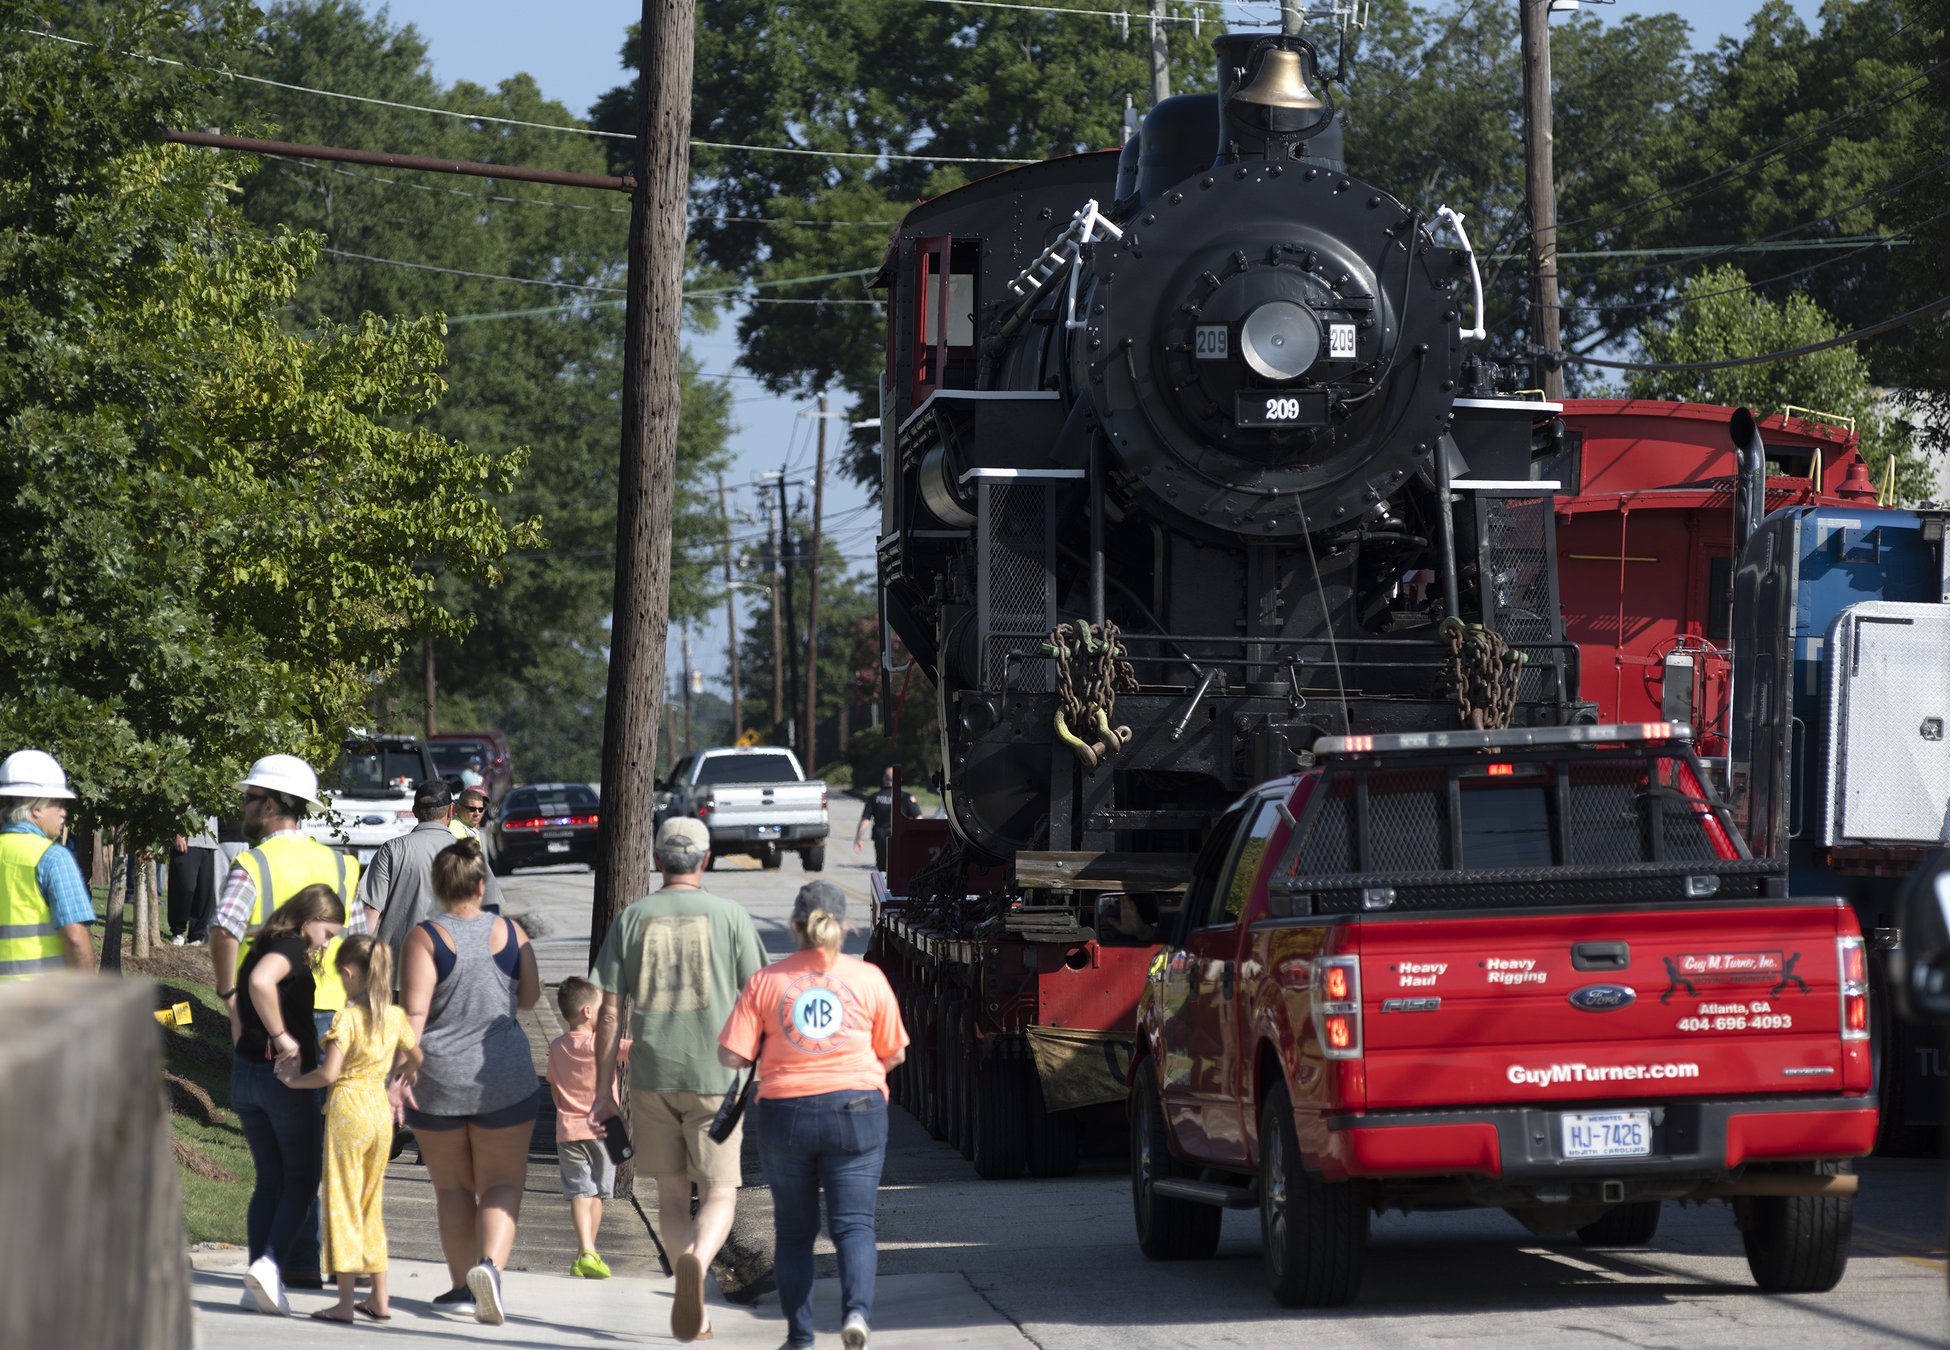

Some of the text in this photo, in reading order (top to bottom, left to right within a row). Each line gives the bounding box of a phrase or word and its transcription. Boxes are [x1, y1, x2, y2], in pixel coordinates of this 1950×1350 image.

[1198, 331, 1226, 352] 209
[1331, 329, 1354, 351] 209
[1266, 399, 1300, 420] 209
[1399, 962, 1448, 975] Heavy
[1487, 958, 1536, 971] Heavy
[1685, 955, 1706, 973] Guy
[1707, 954, 1722, 969] M.
[1759, 954, 1777, 968] Inc.
[1399, 975, 1436, 987] Haul
[1488, 971, 1547, 985] Rigging
[1585, 989, 1622, 1005] Ford
[803, 998, 832, 1028] MB
[1698, 1001, 1771, 1015] Atlanta, GA
[1677, 1015, 1792, 1031] 404-696-4093
[1507, 1063, 1699, 1087] GuyMTurner.com
[1570, 1123, 1642, 1148] HJ-7426
